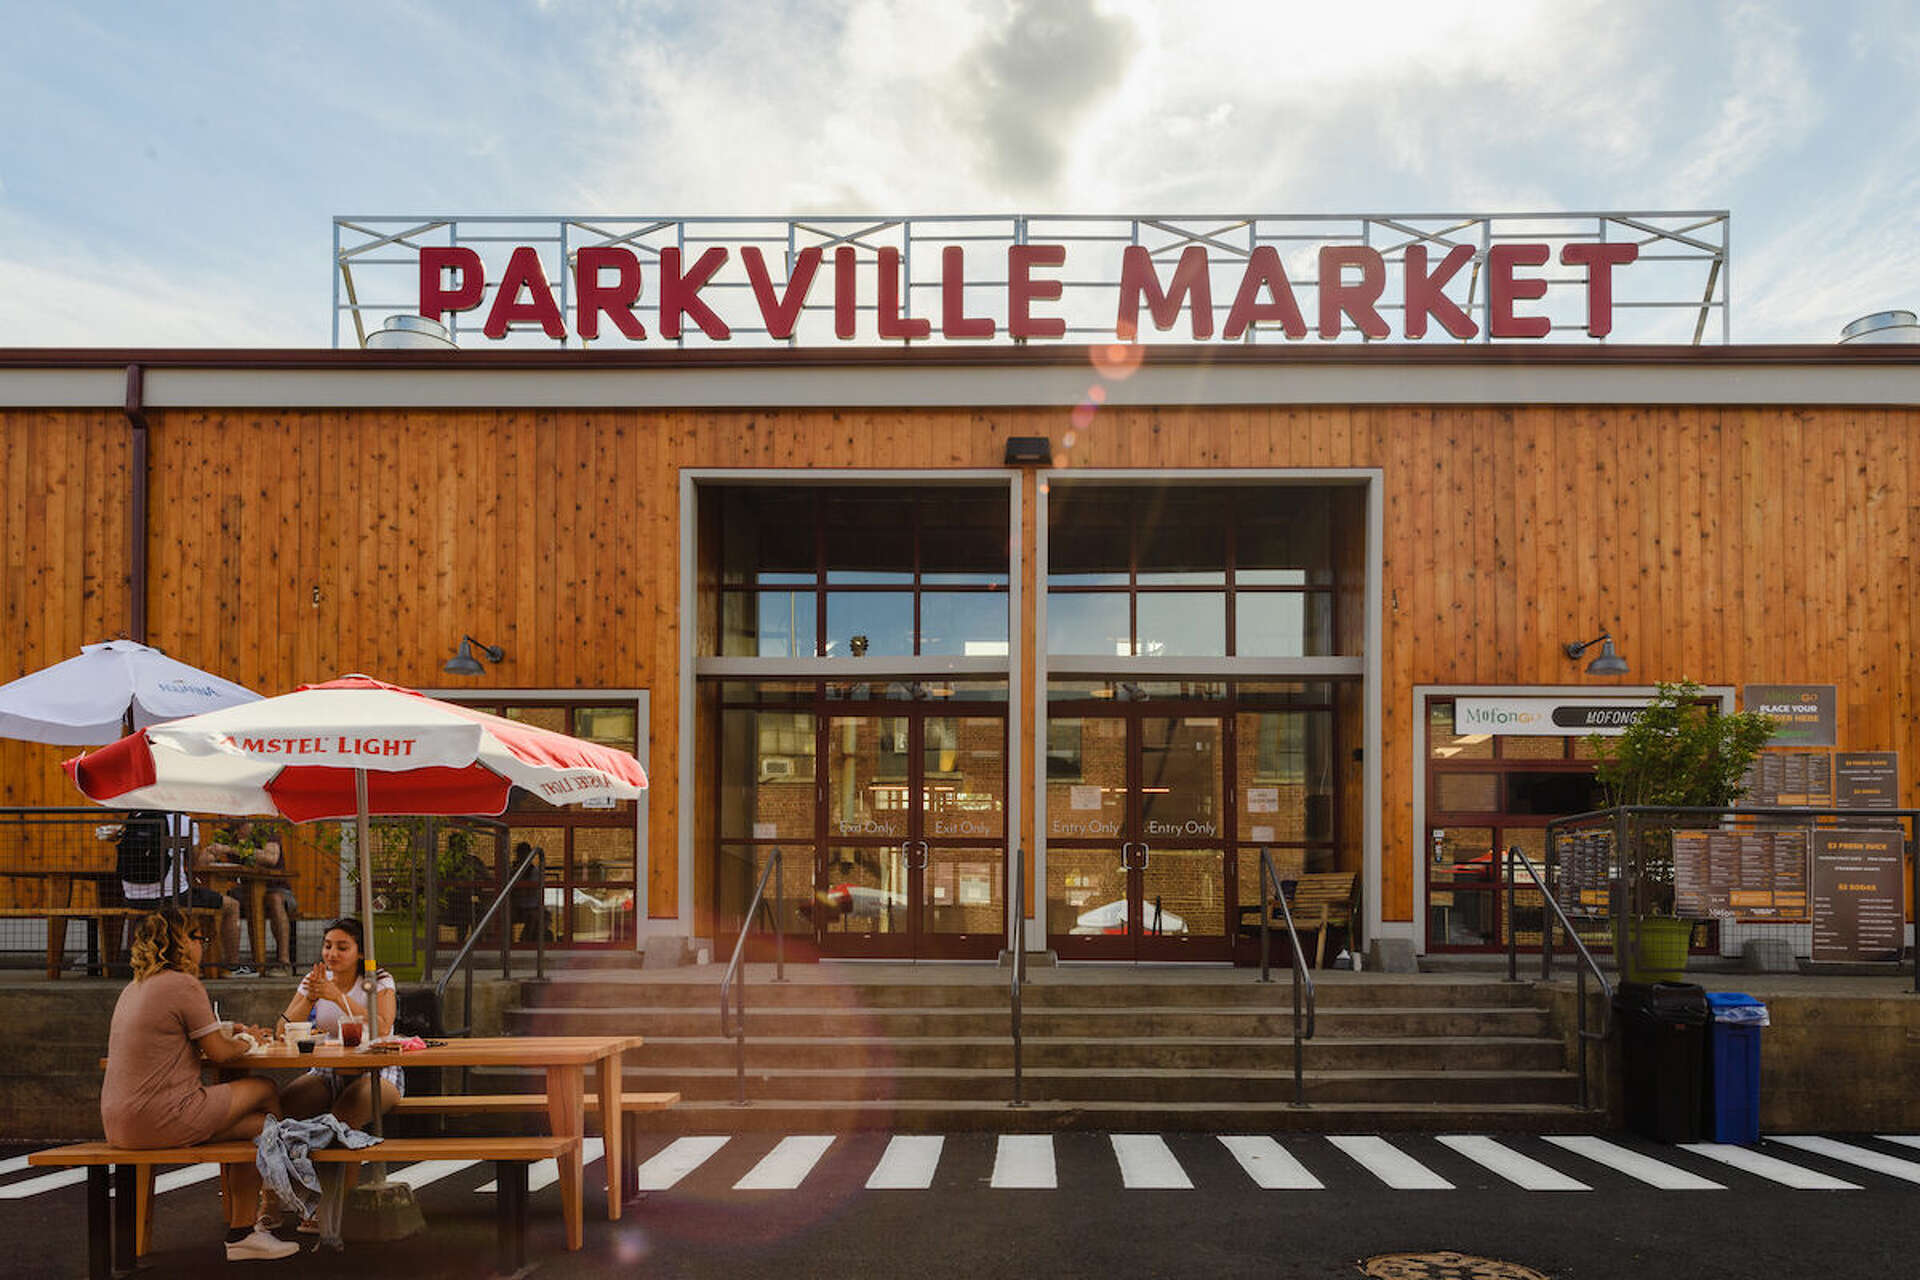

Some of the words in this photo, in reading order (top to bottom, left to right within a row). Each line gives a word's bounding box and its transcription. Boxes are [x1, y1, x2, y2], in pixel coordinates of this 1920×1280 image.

[420, 246, 1066, 341] PARKVILLE
[1116, 243, 1639, 341] MARKET
[1759, 704, 1790, 713] PLACE
[1792, 704, 1818, 713] YOUR
[338, 736, 416, 756] LIGHT
[839, 821, 862, 833] Exit
[864, 821, 897, 835] Only
[935, 821, 957, 834] Exit
[960, 821, 991, 835] Only
[1053, 820, 1087, 836] Entry
[1088, 820, 1121, 836] Only
[1150, 820, 1183, 836] Entry
[1185, 820, 1217, 836] Only
